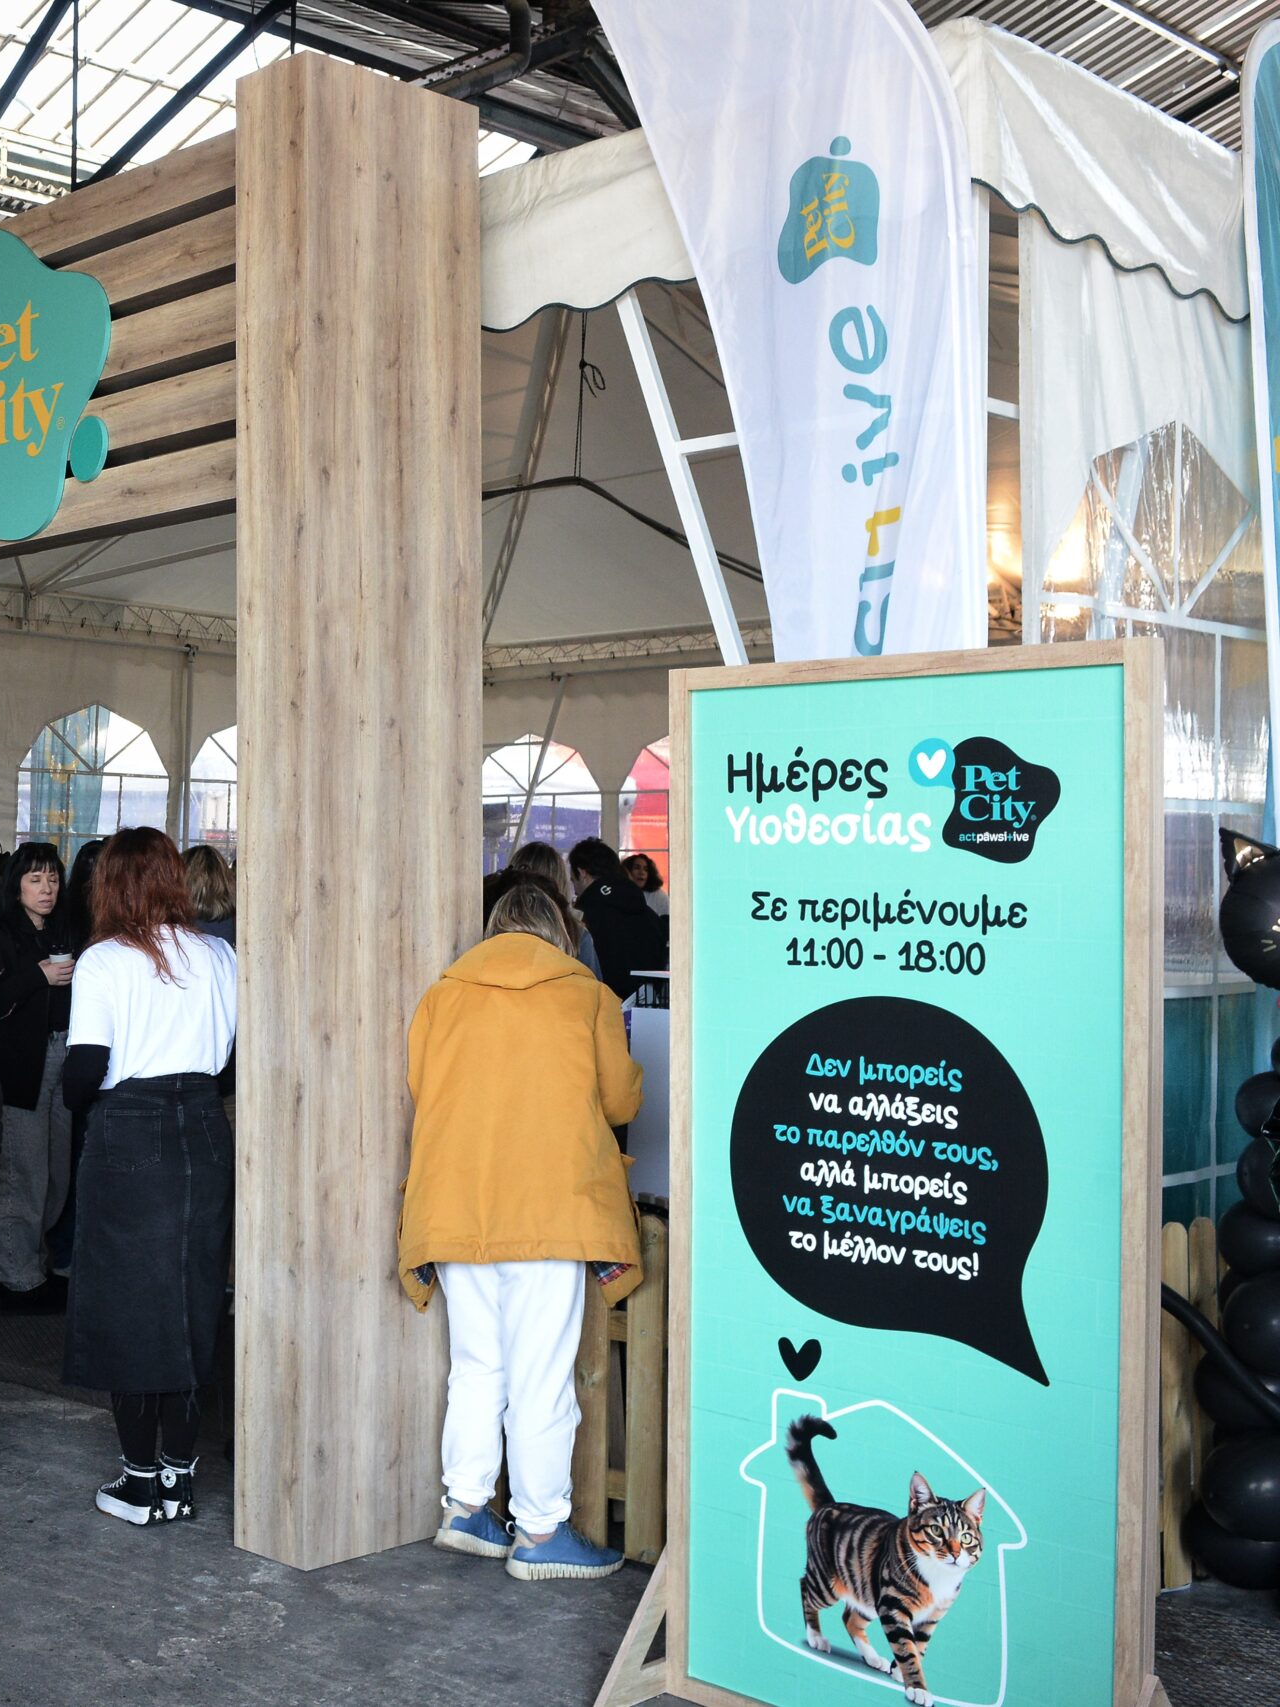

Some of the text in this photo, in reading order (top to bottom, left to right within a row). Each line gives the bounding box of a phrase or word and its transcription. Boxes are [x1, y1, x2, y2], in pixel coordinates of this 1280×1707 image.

[800, 197, 831, 262] Pet
[822, 171, 856, 249] City
[727, 746, 889, 804] Ημέρες
[961, 765, 1021, 792] Pet
[725, 799, 932, 853] Υιοθεσίας
[959, 793, 1036, 829] City
[750, 888, 1028, 935] Σε περιμένουμε
[786, 937, 864, 969] 11:00
[898, 939, 986, 976] 18:00
[805, 1053, 963, 1093] Δεν μπορείς
[808, 1091, 959, 1130] να αλλάξεις
[773, 1124, 999, 1172] το παρελθόν τους,
[800, 1159, 968, 1206] αλλά μπορείς
[782, 1194, 987, 1245] να ξαναγράψεις
[788, 1230, 980, 1281] το μέλλον τους!
